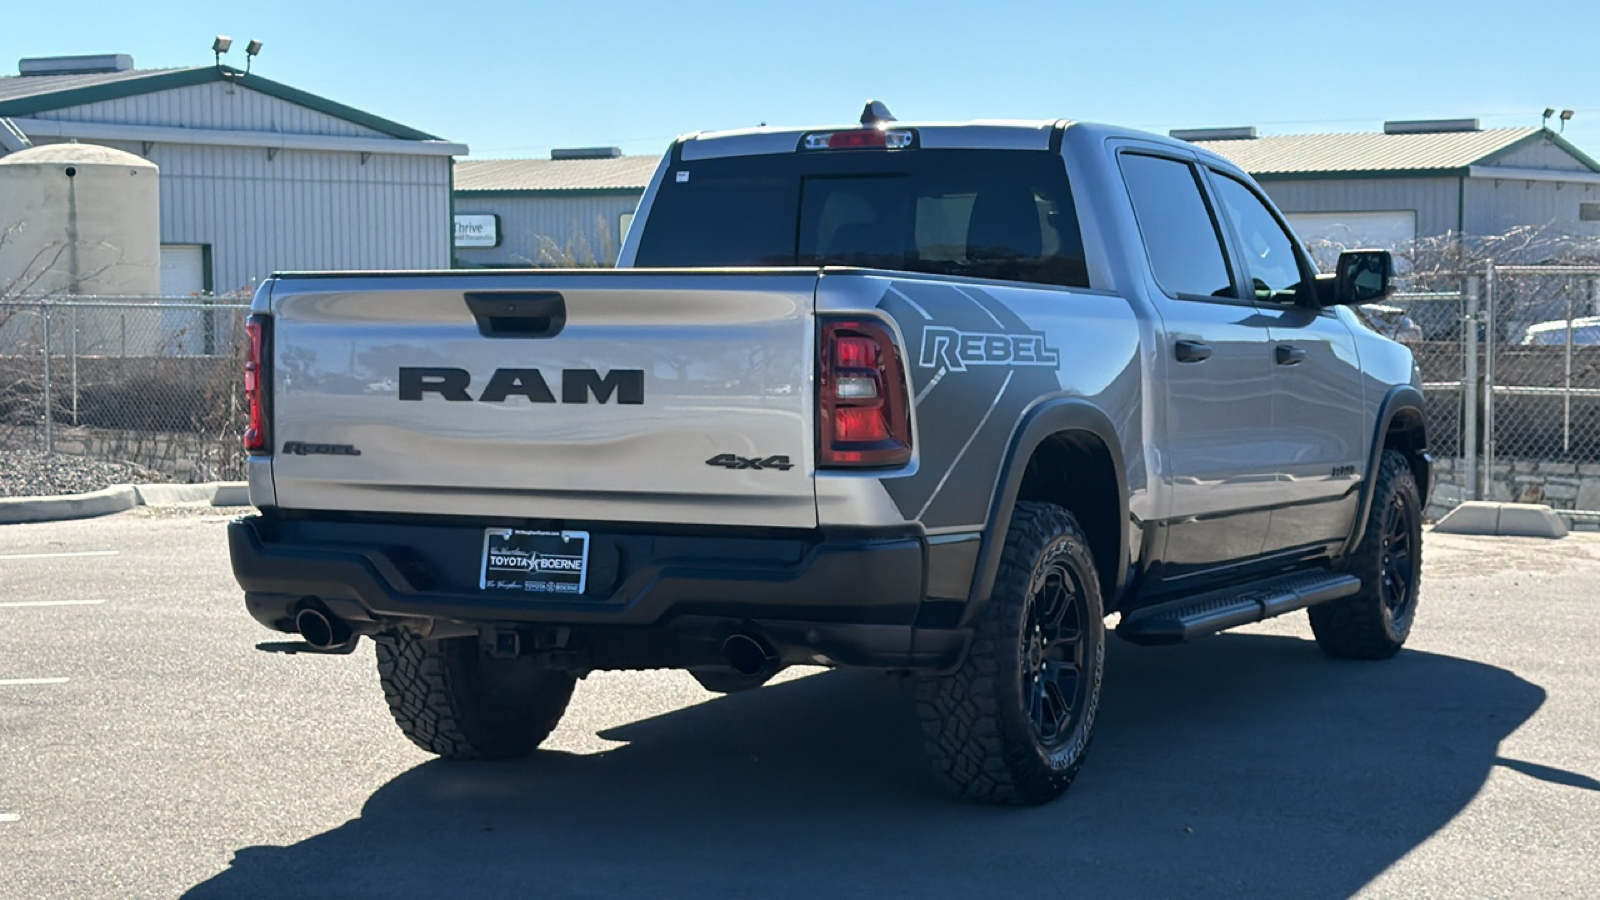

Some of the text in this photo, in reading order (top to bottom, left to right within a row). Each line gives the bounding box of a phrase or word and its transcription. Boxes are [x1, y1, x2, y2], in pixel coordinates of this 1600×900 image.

[919, 325, 1059, 371] REBEL
[398, 366, 645, 405] RAM
[705, 453, 795, 471] 4x4
[490, 555, 582, 570] TOYOTA BOERNE
